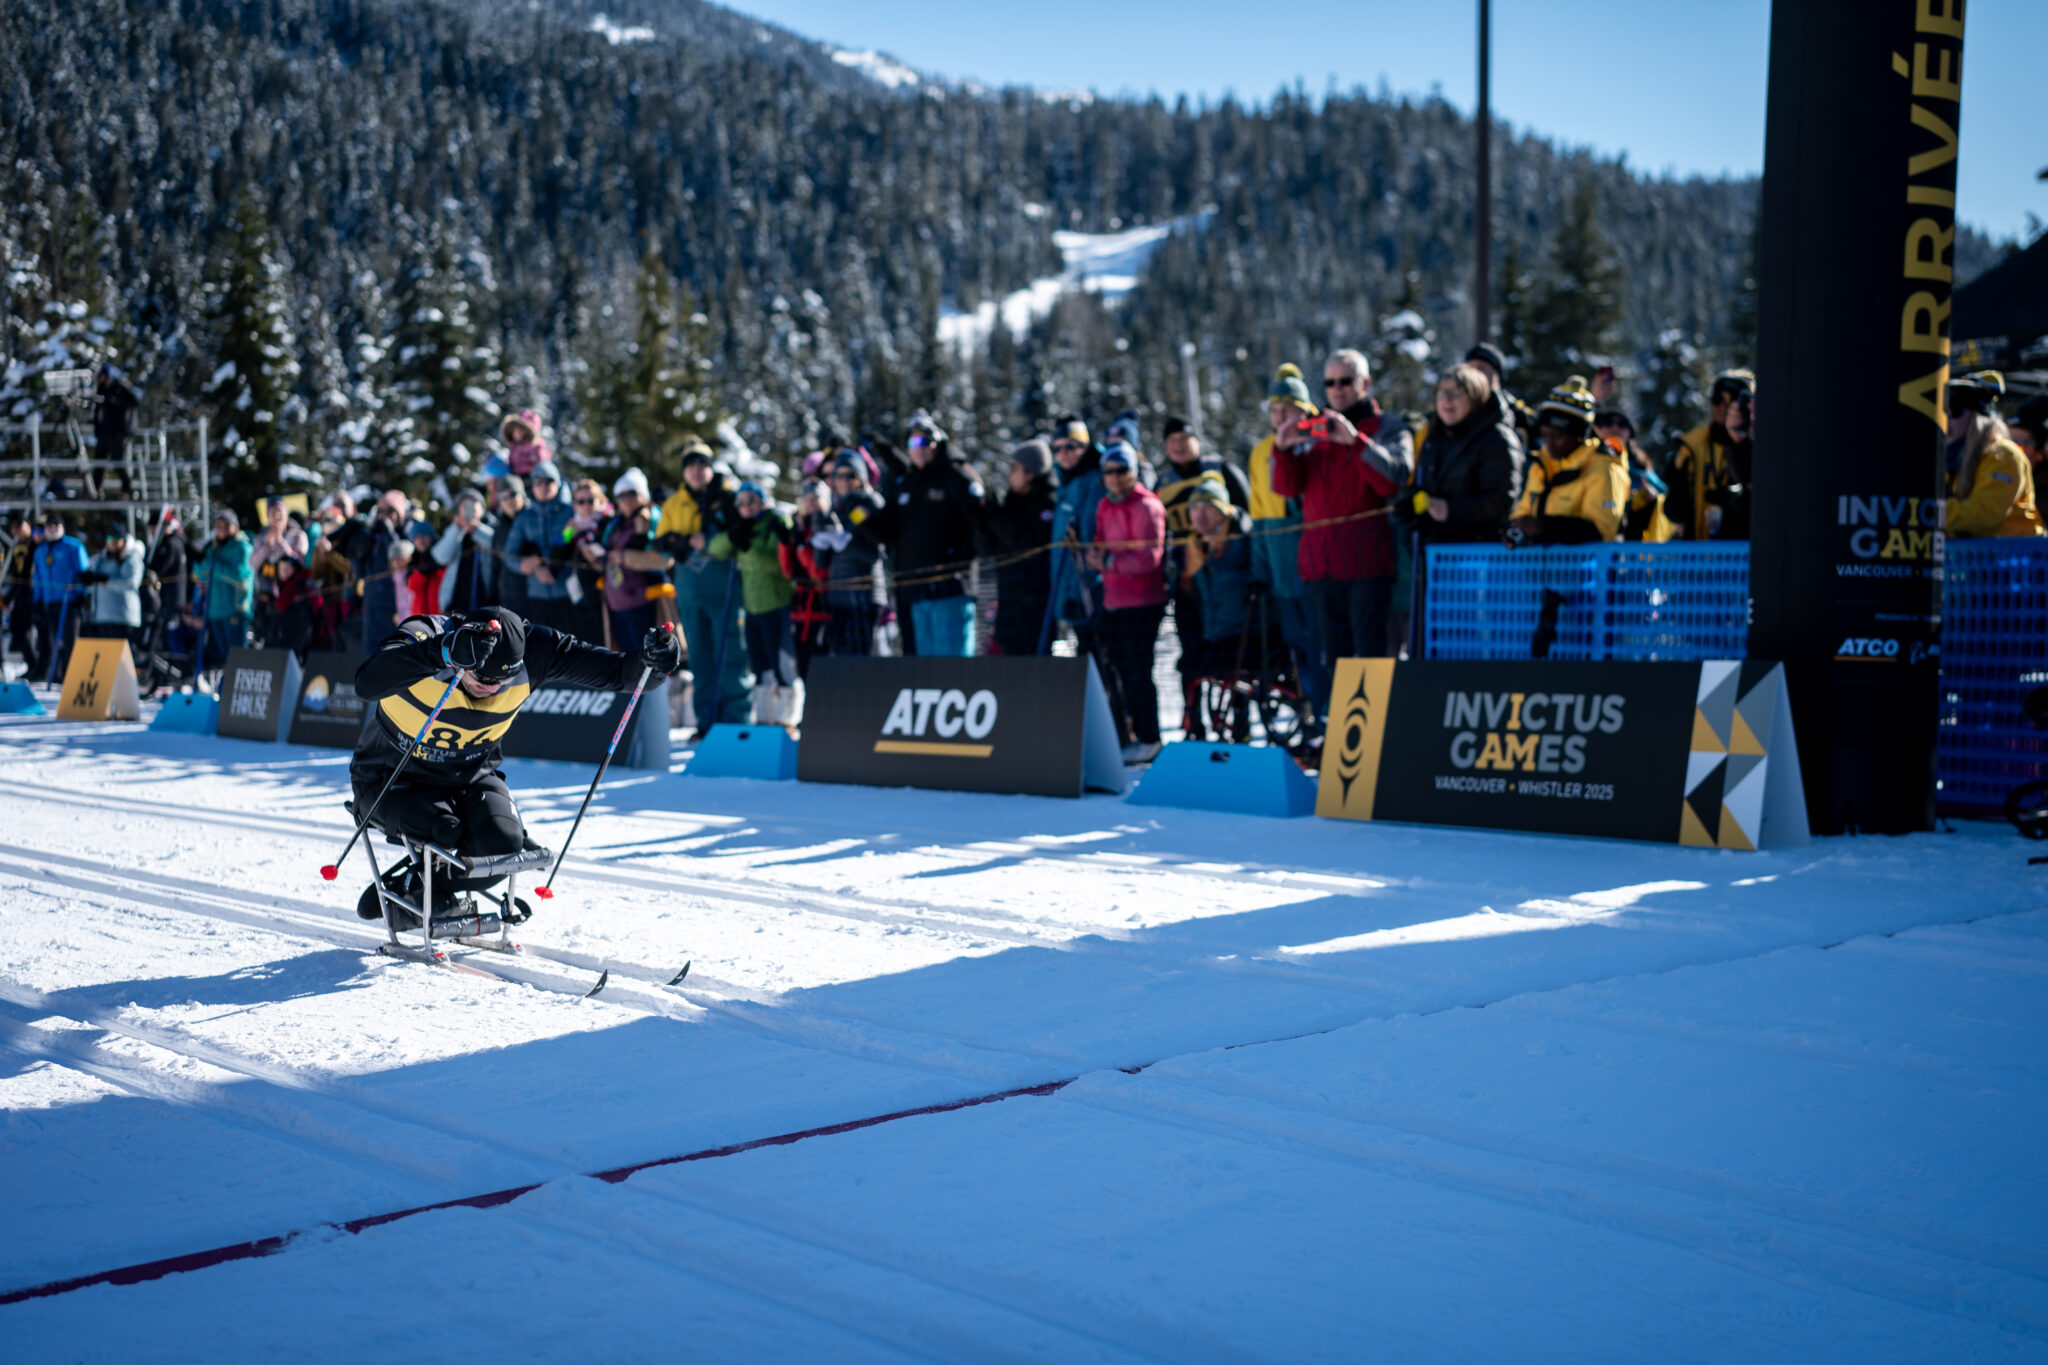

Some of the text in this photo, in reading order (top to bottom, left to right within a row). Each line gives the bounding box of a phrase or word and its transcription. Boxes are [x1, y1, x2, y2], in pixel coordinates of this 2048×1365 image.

[1836, 564, 1913, 579] VANCOUVER
[1837, 637, 1900, 657] ATCO
[72, 680, 99, 708] AM
[234, 668, 273, 694] FISHER
[881, 688, 998, 739] ATCO
[1443, 691, 1626, 734] INVICTUS
[1450, 731, 1588, 774] GAMES
[1434, 776, 1615, 801] VANCOUVER WHISTLER 2025
